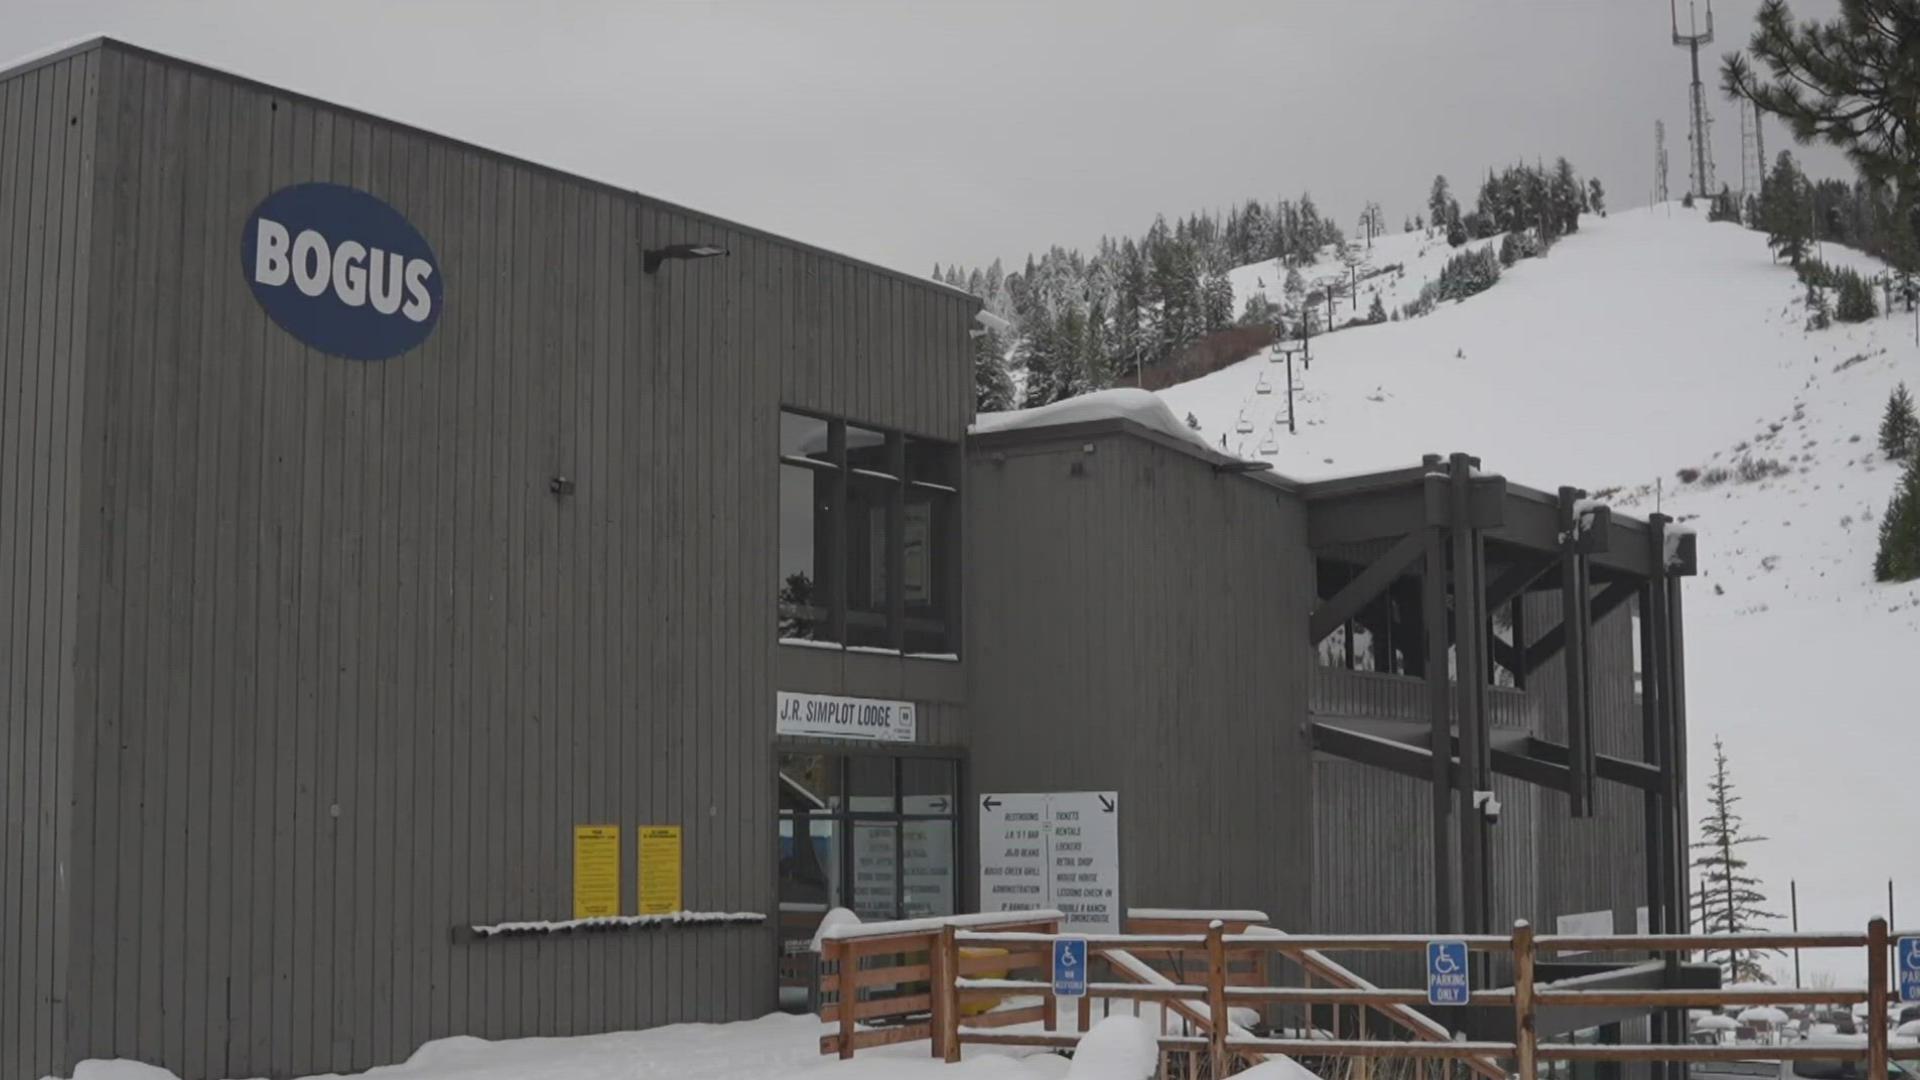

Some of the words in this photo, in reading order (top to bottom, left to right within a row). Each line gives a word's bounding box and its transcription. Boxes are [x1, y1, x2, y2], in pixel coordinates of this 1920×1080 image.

[255, 216, 433, 323] BOGUS
[781, 699, 802, 721] J.R.
[806, 701, 856, 725] SIMPLOT
[858, 704, 892, 728] LODGE
[1004, 813, 1039, 821] RESTROOMS
[1056, 811, 1079, 820] TICKETS
[1055, 827, 1081, 836] RENTALS
[1055, 842, 1082, 851] LOCKERS
[1056, 857, 1075, 866] RETAIL
[1077, 857, 1094, 866] SHOP
[1024, 867, 1040, 876] GRILL
[992, 885, 1040, 893] ADMINISTRATION
[1083, 888, 1103, 897] CHECK
[1086, 903, 1107, 912] RANCH
[1431, 973, 1465, 986] PARKING
[1437, 988, 1459, 1000] ONLY
